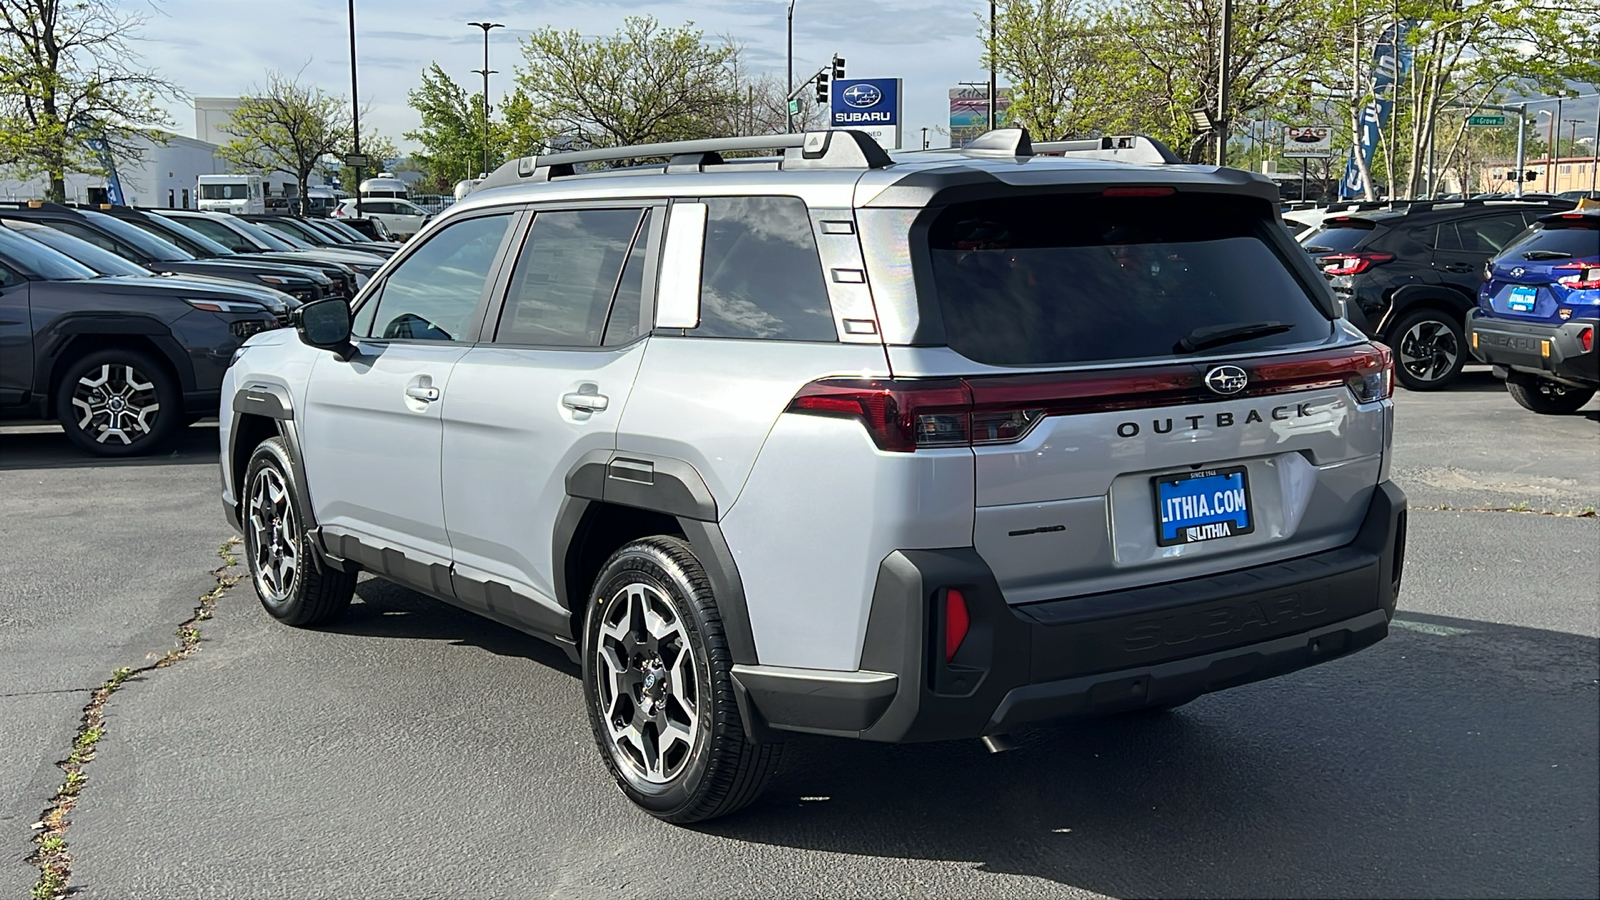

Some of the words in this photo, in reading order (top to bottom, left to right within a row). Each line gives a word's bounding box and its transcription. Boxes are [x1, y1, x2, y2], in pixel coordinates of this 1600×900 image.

[835, 112, 890, 122] SUBARU
[1117, 403, 1311, 438] OUTBACK
[1190, 471, 1205, 479] SINCE
[1161, 488, 1246, 523] LITHIA.COM
[1197, 522, 1231, 541] LITHIA
[1124, 588, 1329, 652] SUBARU
